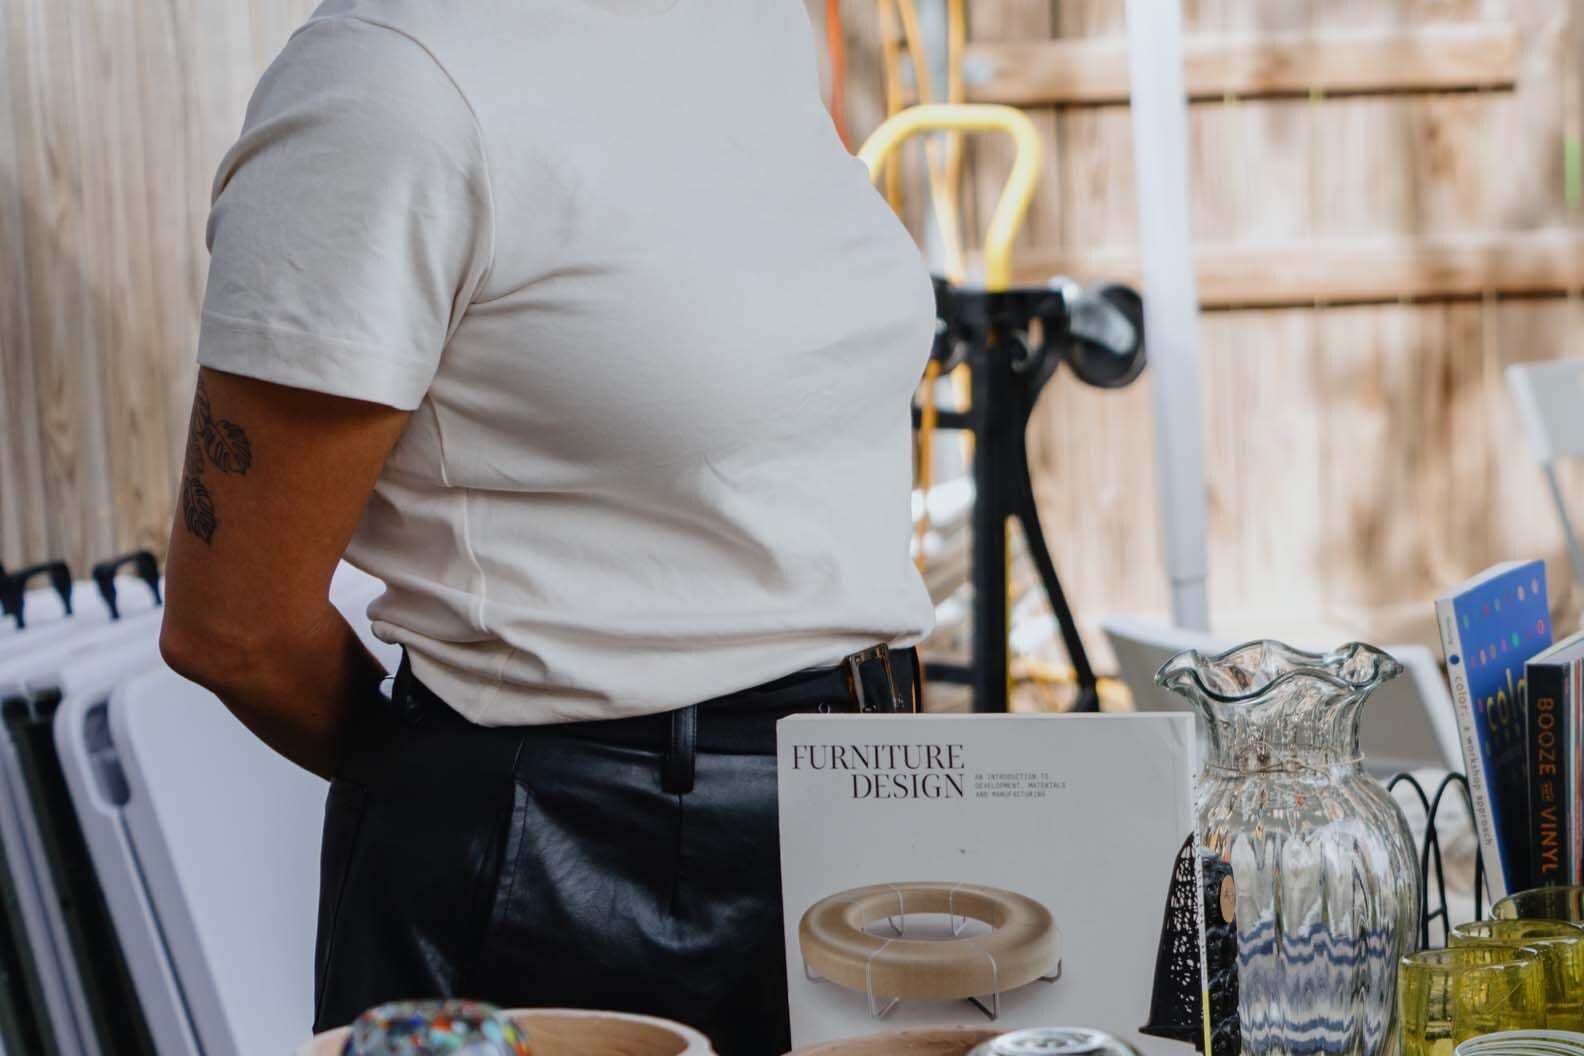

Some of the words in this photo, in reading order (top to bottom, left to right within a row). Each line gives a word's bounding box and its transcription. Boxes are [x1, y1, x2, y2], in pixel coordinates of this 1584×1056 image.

[1486, 667, 1527, 733] colo
[792, 744, 965, 770] FURNITURE
[1537, 697, 1556, 776] BOOZE
[851, 773, 965, 799] DESIGN
[1464, 735, 1481, 791] workshop
[1475, 794, 1493, 847] approach
[1540, 805, 1559, 873] VINYL
